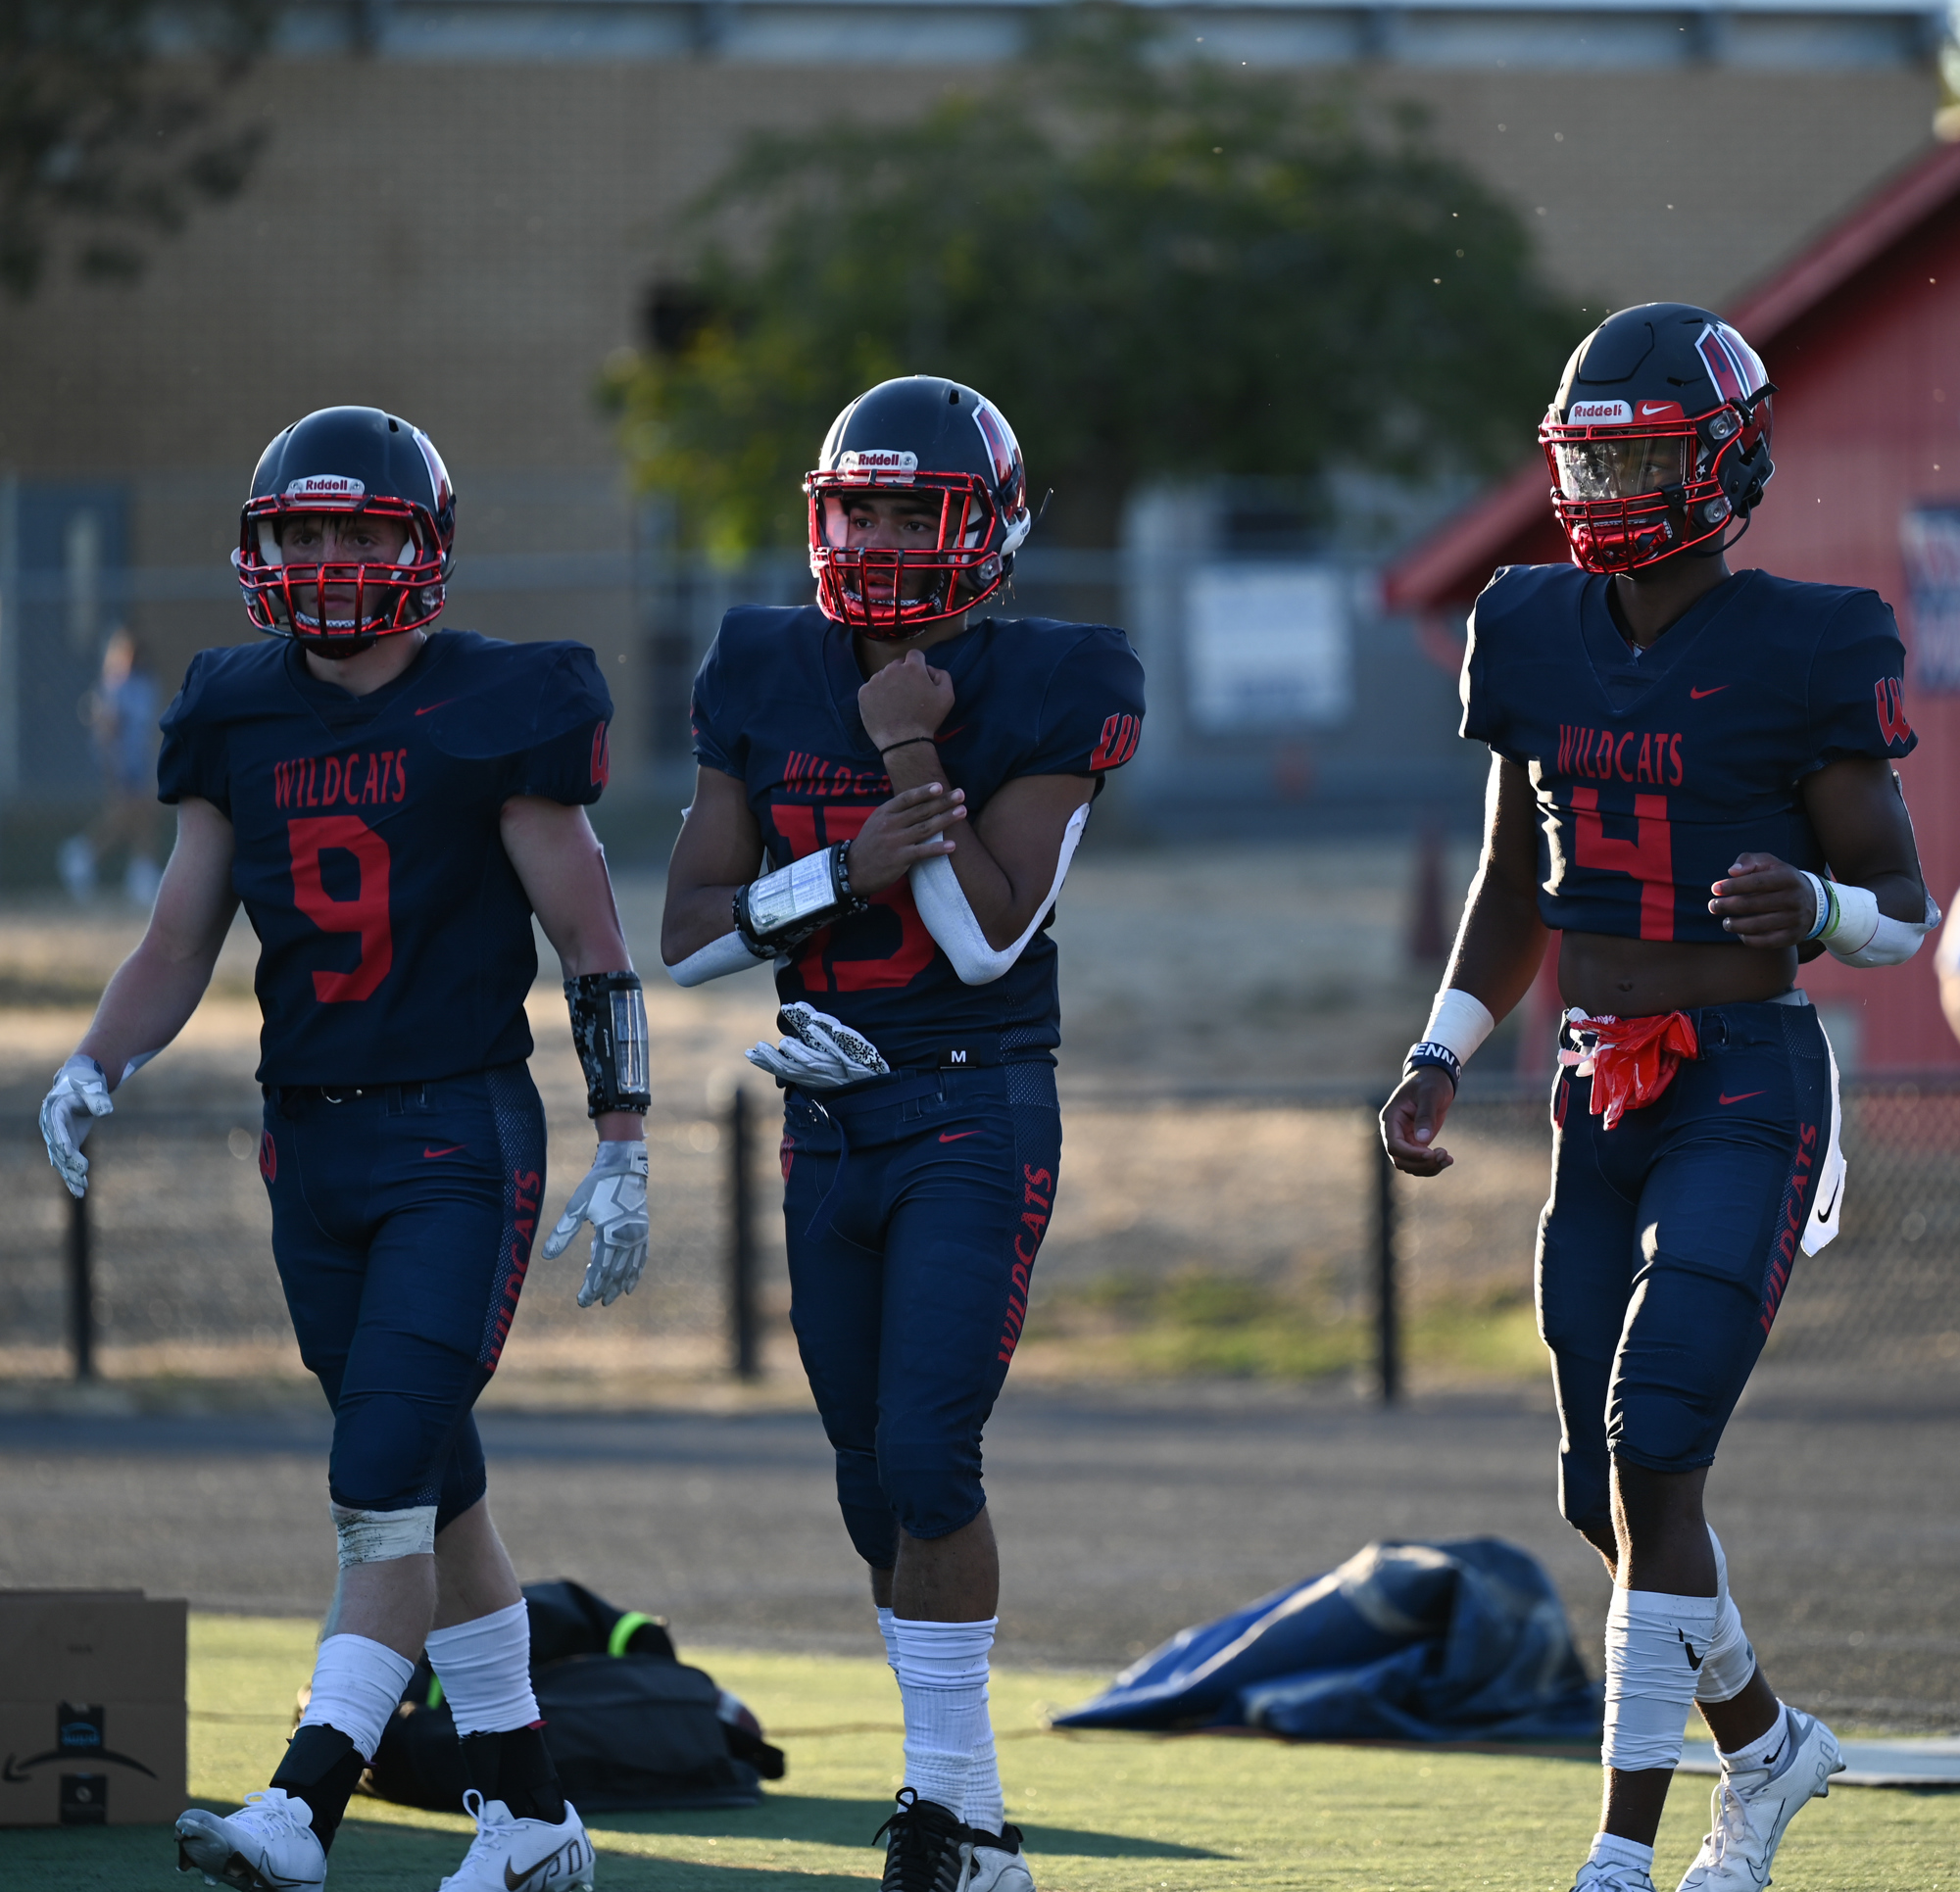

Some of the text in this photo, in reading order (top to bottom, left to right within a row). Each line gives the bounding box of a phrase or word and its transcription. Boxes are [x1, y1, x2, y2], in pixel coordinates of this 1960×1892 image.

[1574, 405, 1622, 417] Riddell
[306, 479, 348, 491] Riddell
[858, 454, 900, 466] Riddell
[273, 749, 407, 809] WILDCATS
[783, 751, 894, 797] WILDCA
[1557, 724, 1683, 787] WILDCATS
[1570, 786, 1675, 942] 4
[287, 815, 392, 1003] 9
[771, 804, 935, 993] 15
[951, 1050, 966, 1063] M
[1760, 1123, 1816, 1335] WILDCATS
[485, 1169, 540, 1372] WILDCATS
[998, 1163, 1052, 1364] WILDCATS
